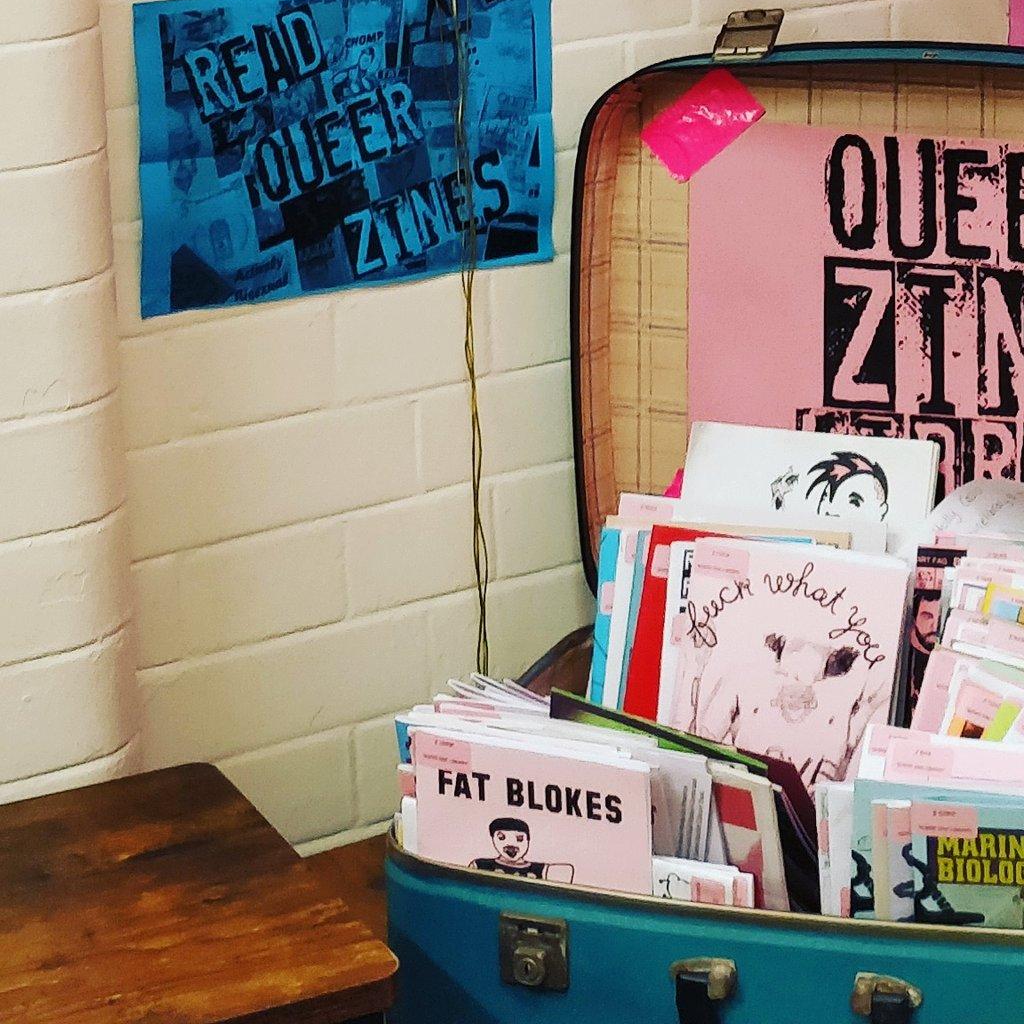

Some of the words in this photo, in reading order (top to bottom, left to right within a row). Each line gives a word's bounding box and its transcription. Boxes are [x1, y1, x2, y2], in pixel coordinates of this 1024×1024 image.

[184, 9, 325, 121] READ
[345, 31, 384, 48] CHOMP
[255, 86, 424, 203] QUEER
[344, 150, 511, 277] ZINES
[438, 769, 490, 801] FAT
[506, 777, 623, 824] BLOKES
